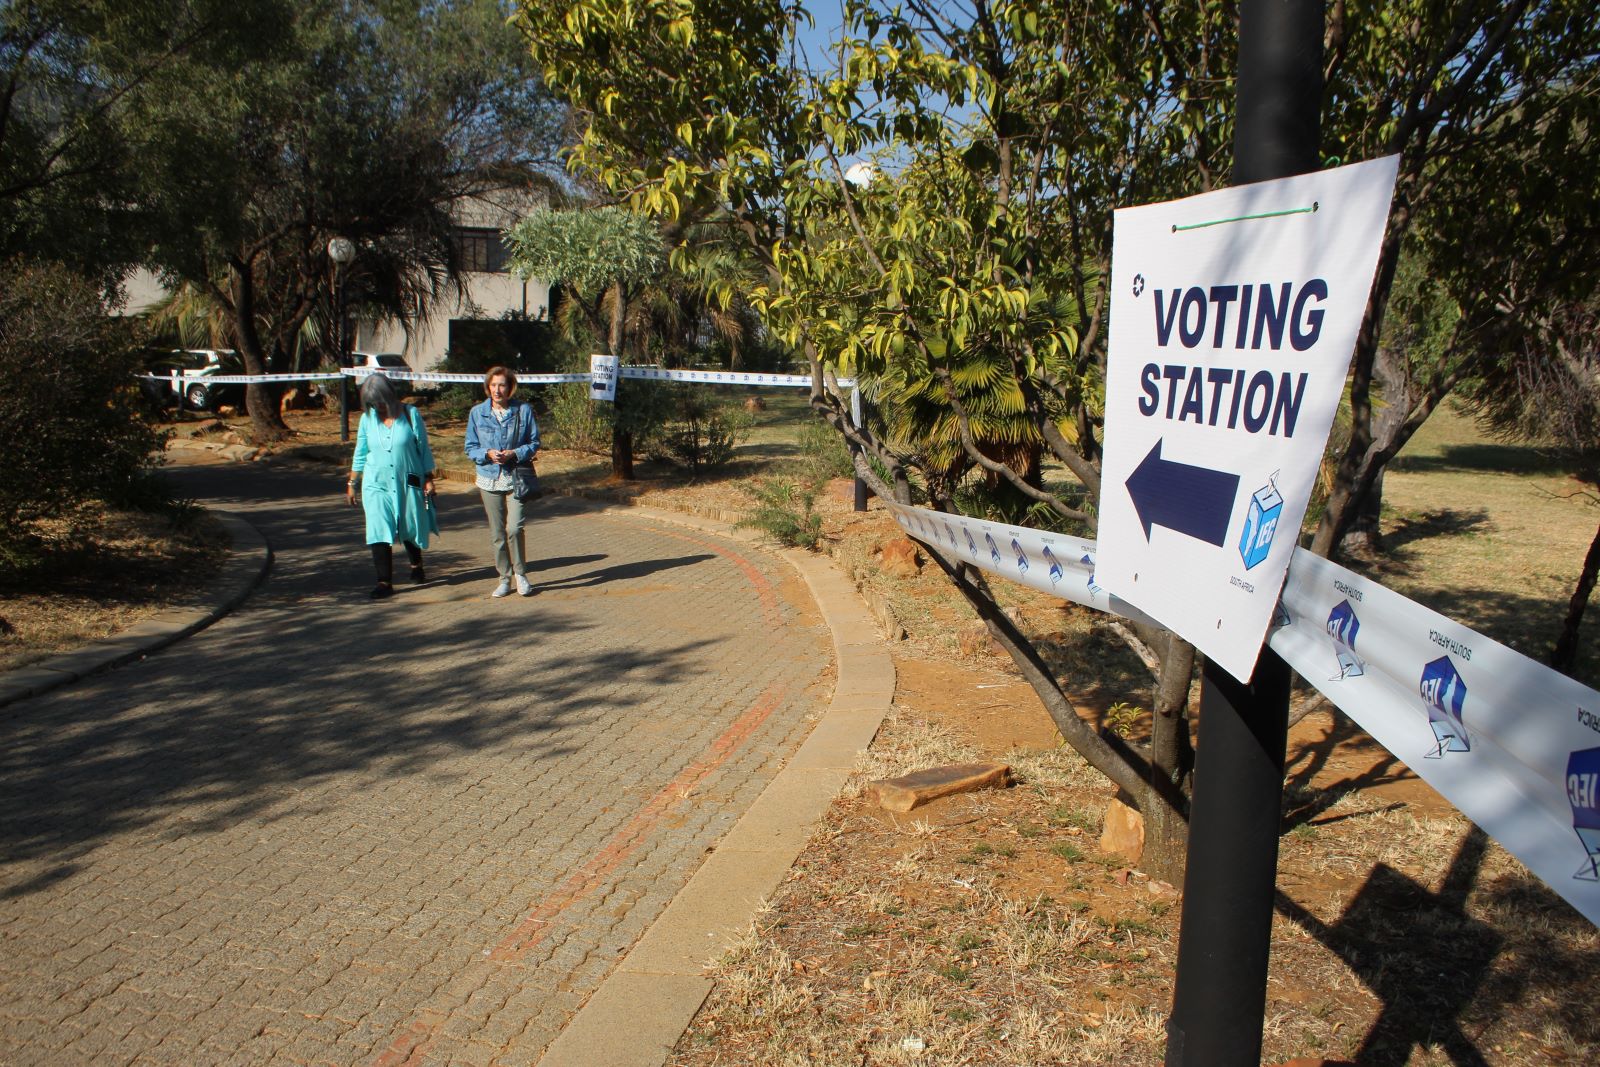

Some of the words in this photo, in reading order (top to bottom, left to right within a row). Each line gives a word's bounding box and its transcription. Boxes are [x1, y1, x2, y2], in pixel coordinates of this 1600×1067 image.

[1153, 278, 1328, 352] VOTING
[593, 365, 614, 373] VOTING
[593, 372, 613, 380] STATION
[1138, 362, 1309, 438] STATION
[1255, 517, 1278, 549] IEC
[1334, 579, 1349, 594] AFRICA
[1348, 587, 1363, 602] SOUTH
[1327, 617, 1343, 640] IEC
[1429, 628, 1452, 649] AFRICA
[1450, 640, 1472, 661] SOUTH
[1421, 677, 1442, 705] IEC
[1577, 707, 1600, 733] RICA
[1568, 773, 1598, 808] IEC
